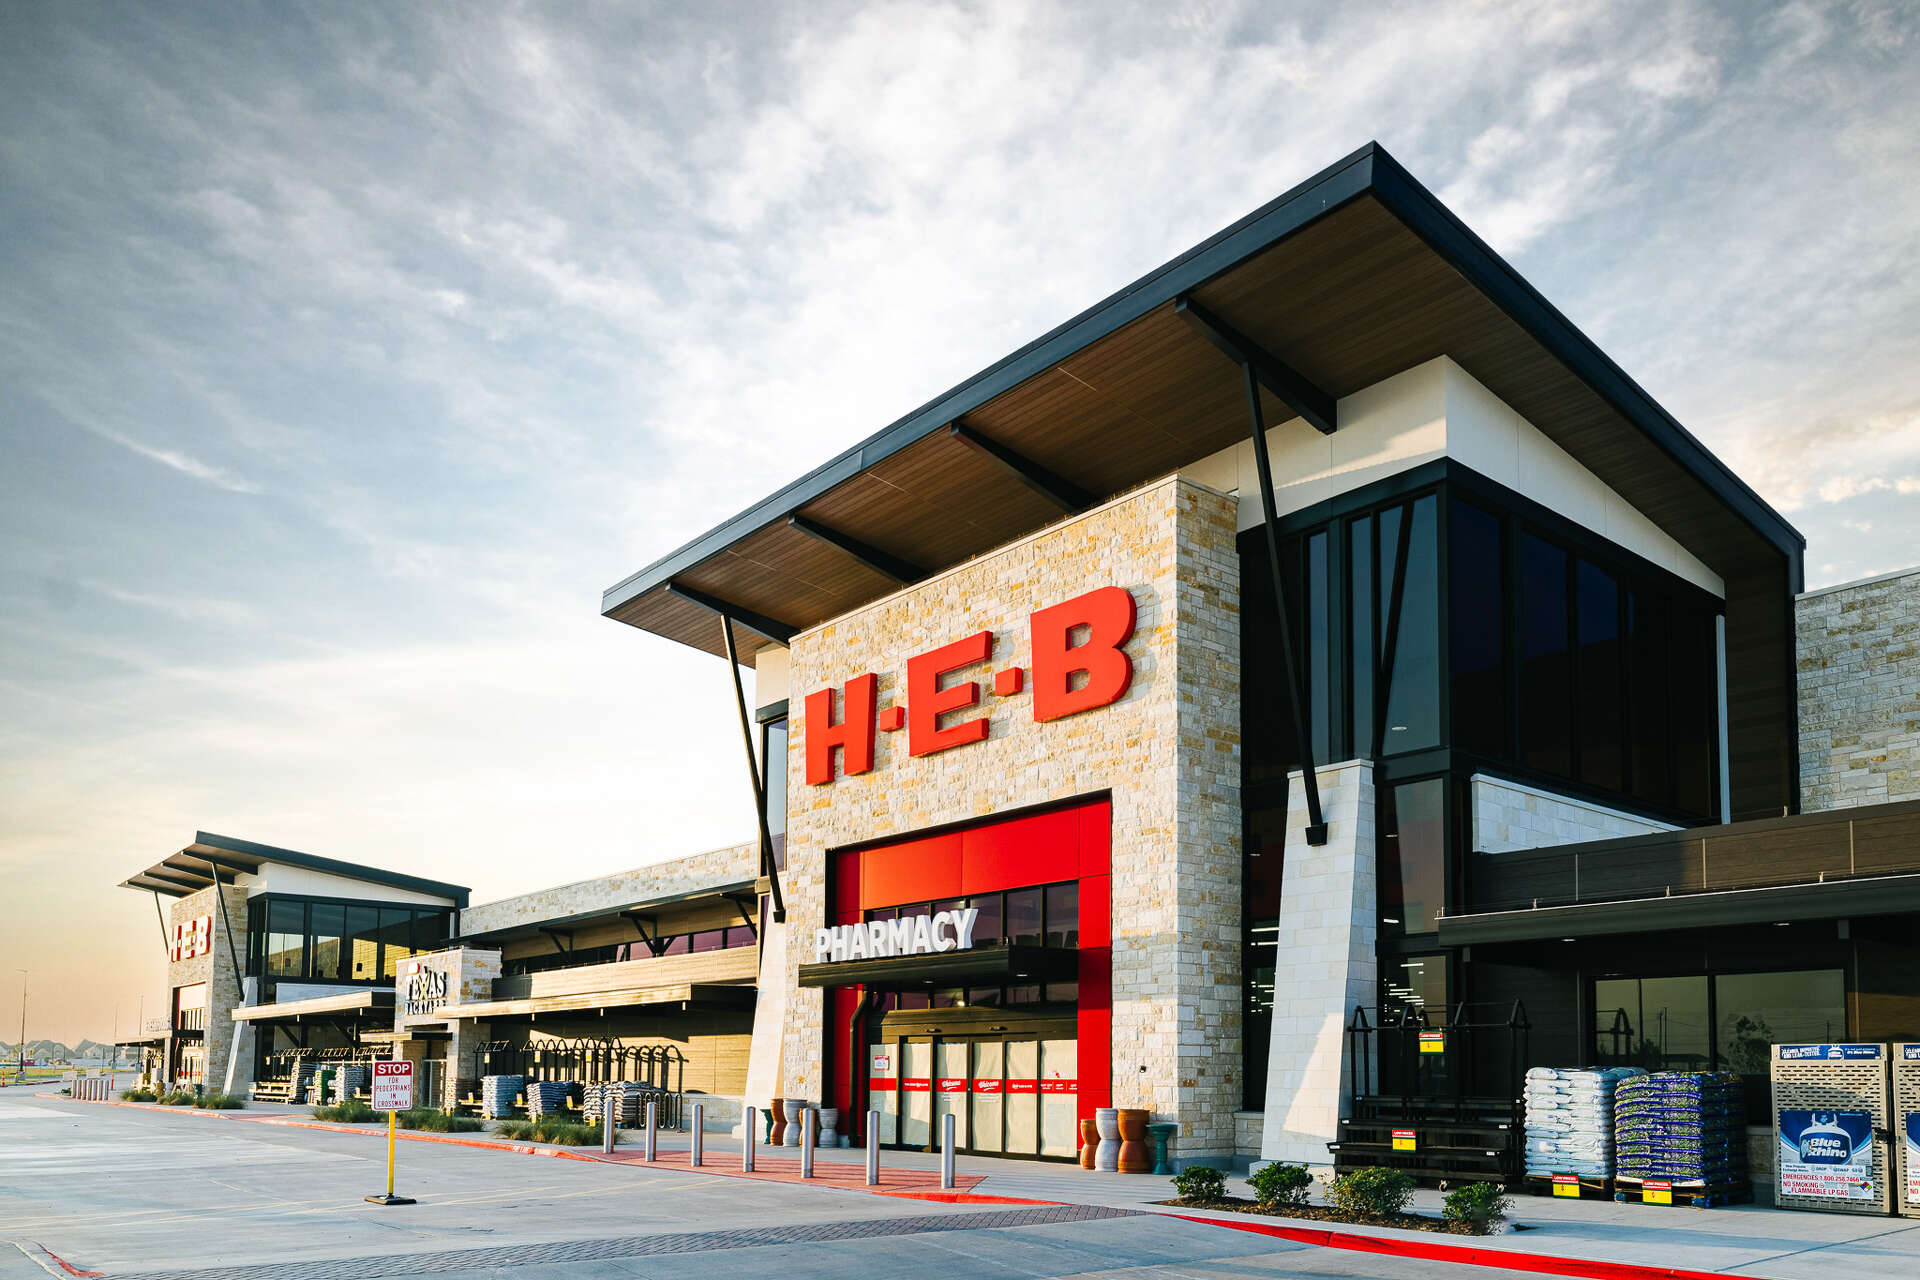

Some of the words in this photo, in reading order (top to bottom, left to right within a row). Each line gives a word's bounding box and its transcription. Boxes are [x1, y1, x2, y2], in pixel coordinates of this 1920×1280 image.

[815, 909, 978, 963] PHARMACY
[406, 968, 447, 1001] TEXAS
[377, 1064, 410, 1074] STOP
[1810, 1138, 1841, 1148] Blue
